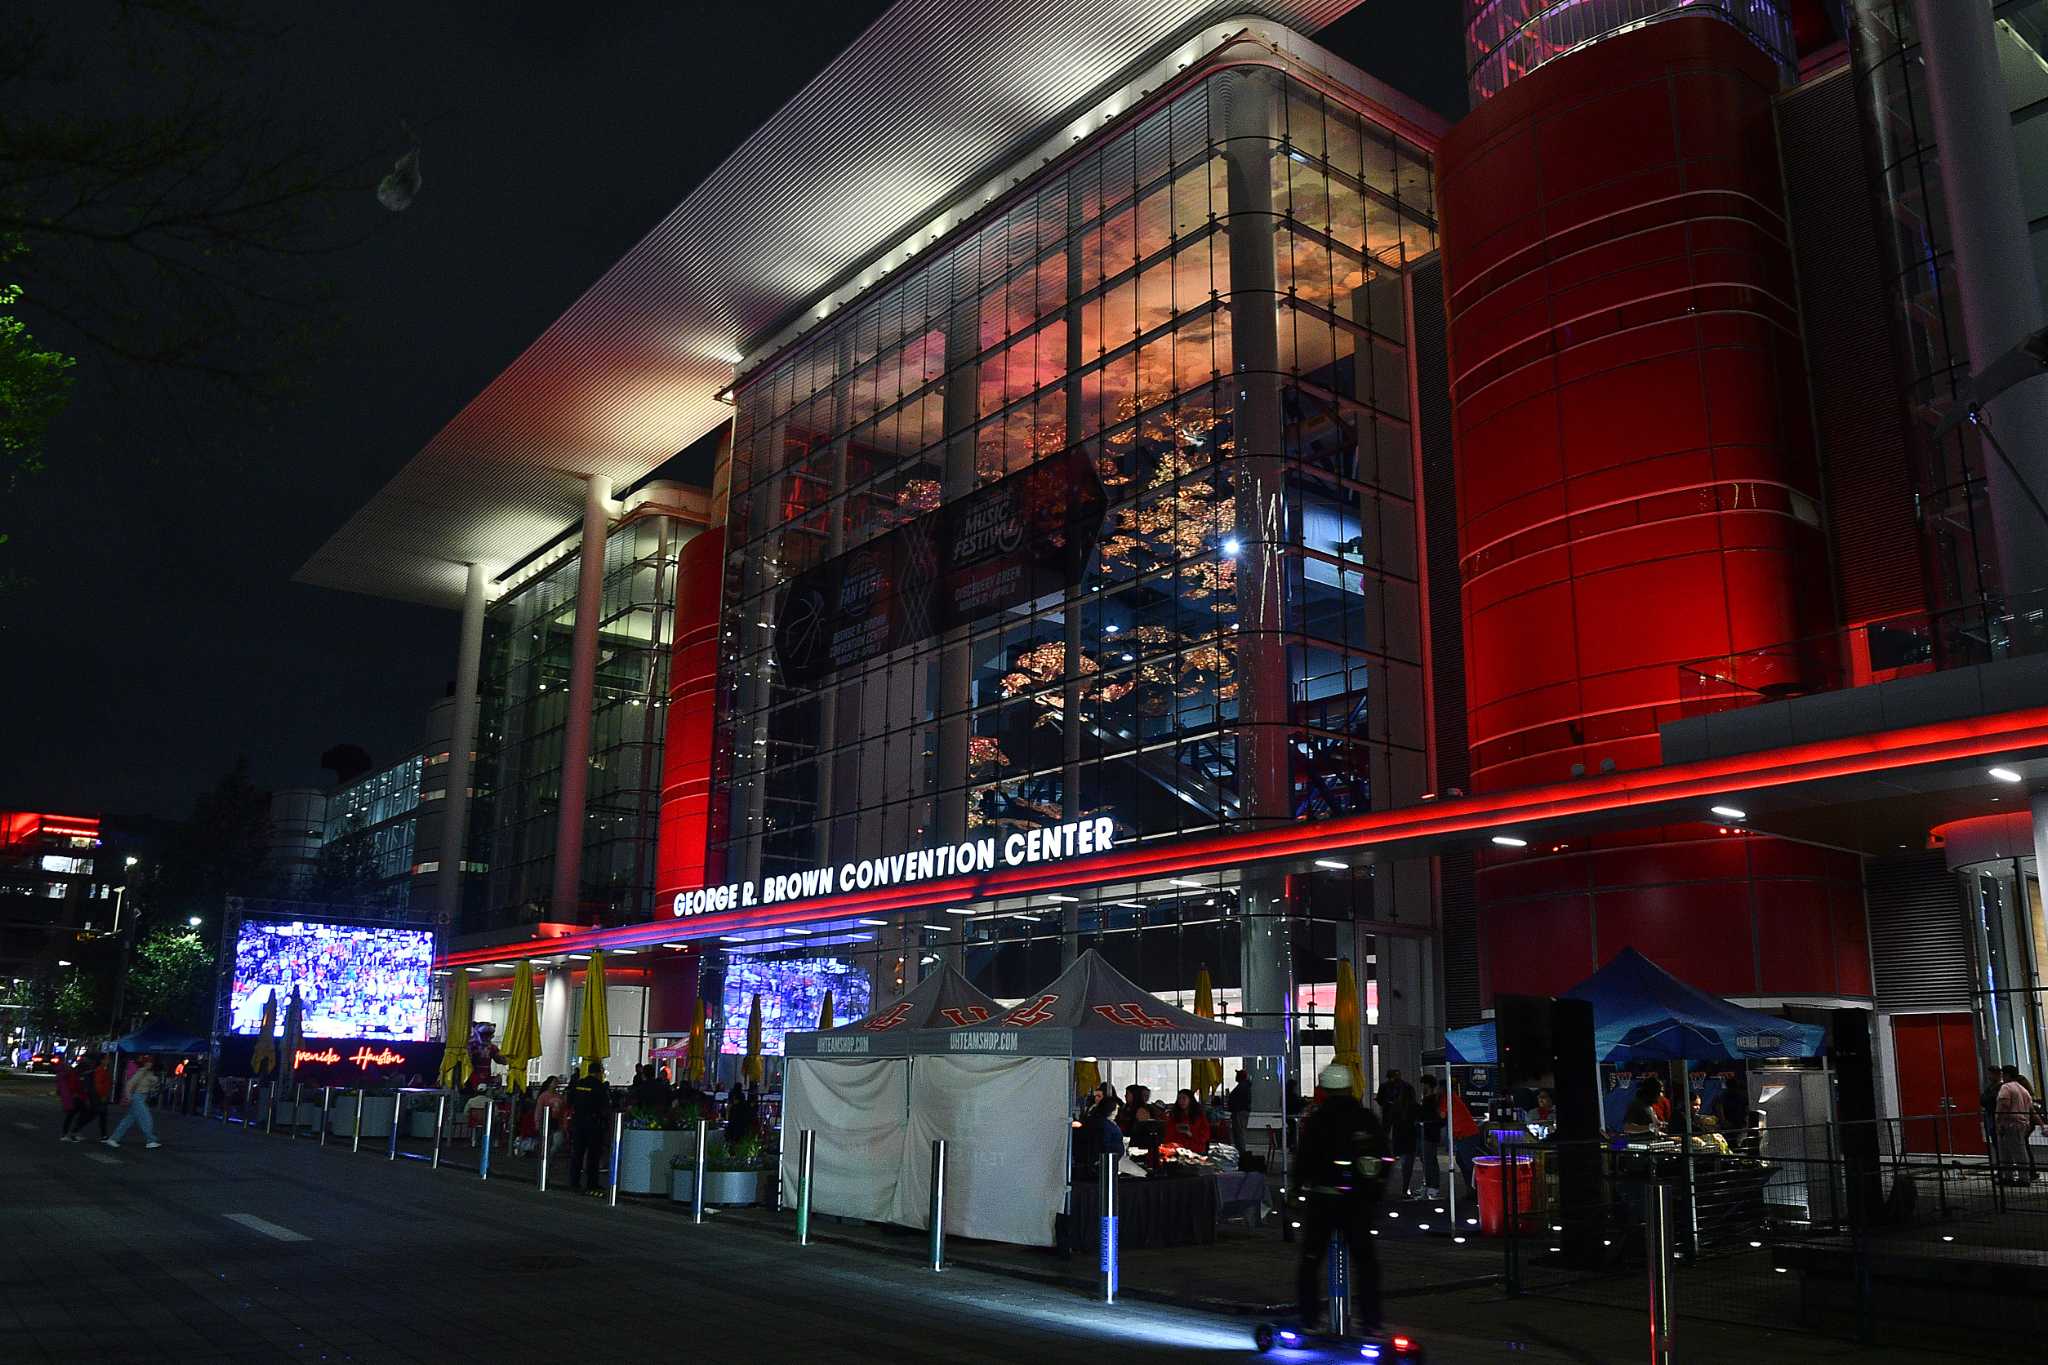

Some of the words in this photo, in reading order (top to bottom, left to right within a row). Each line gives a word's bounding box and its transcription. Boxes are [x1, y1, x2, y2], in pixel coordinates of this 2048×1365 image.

[965, 502, 1009, 537] MUSIC
[673, 882, 738, 917] GEORGE
[741, 879, 757, 906] R.
[763, 866, 833, 905] BROWN
[839, 838, 995, 892] CONVENTION
[1004, 816, 1114, 867] CENTER
[817, 1036, 869, 1053] UHTEAMSHOP.COM
[950, 1031, 1018, 1051] UHTEAMSHOP.COM
[1140, 1032, 1227, 1052] UHTEAMSHOP.COM
[349, 1045, 405, 1071] Houston
